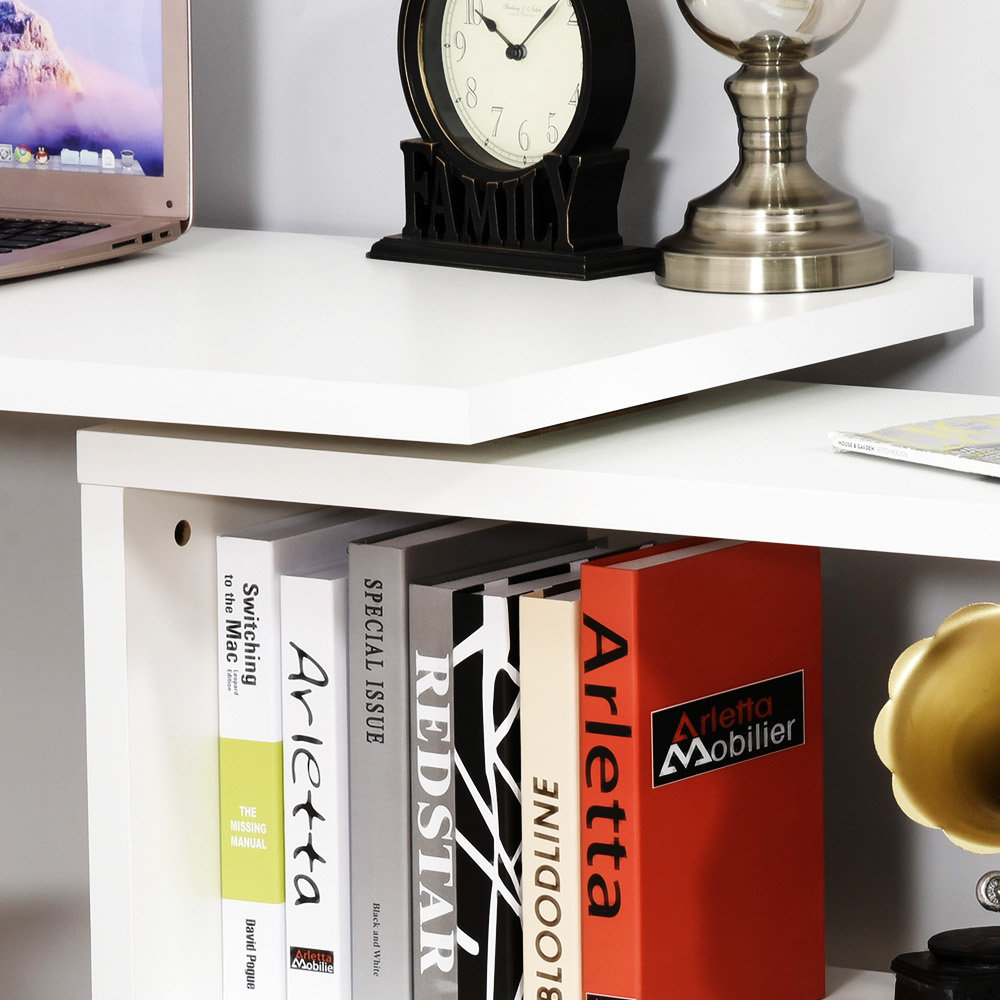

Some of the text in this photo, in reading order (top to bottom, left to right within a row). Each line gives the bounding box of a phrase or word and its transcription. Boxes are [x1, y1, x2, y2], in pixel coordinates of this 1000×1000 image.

[454, 30, 467, 62] 9
[465, 76, 478, 109] 8
[491, 106, 504, 137] 7
[518, 119, 532, 151] 6
[546, 112, 559, 145] 5
[400, 142, 582, 251] FAMILY
[838, 440, 853, 449] HOUSE
[224, 574, 242, 663] to the Mac
[241, 583, 261, 686] Switching
[364, 578, 385, 744] SPECIAL ISSUE
[672, 696, 773, 744] Arletta
[582, 612, 632, 920] Arletta
[659, 718, 796, 778] Mobilier
[288, 641, 329, 906] Arletta
[230, 820, 267, 835] MISSING
[239, 805, 257, 818] THE
[415, 650, 455, 975] REDSTAR
[230, 835, 267, 850] MANUAL
[245, 918, 257, 990] David Pogue
[296, 949, 333, 963] Arletta
[372, 902, 381, 977] Black and White
